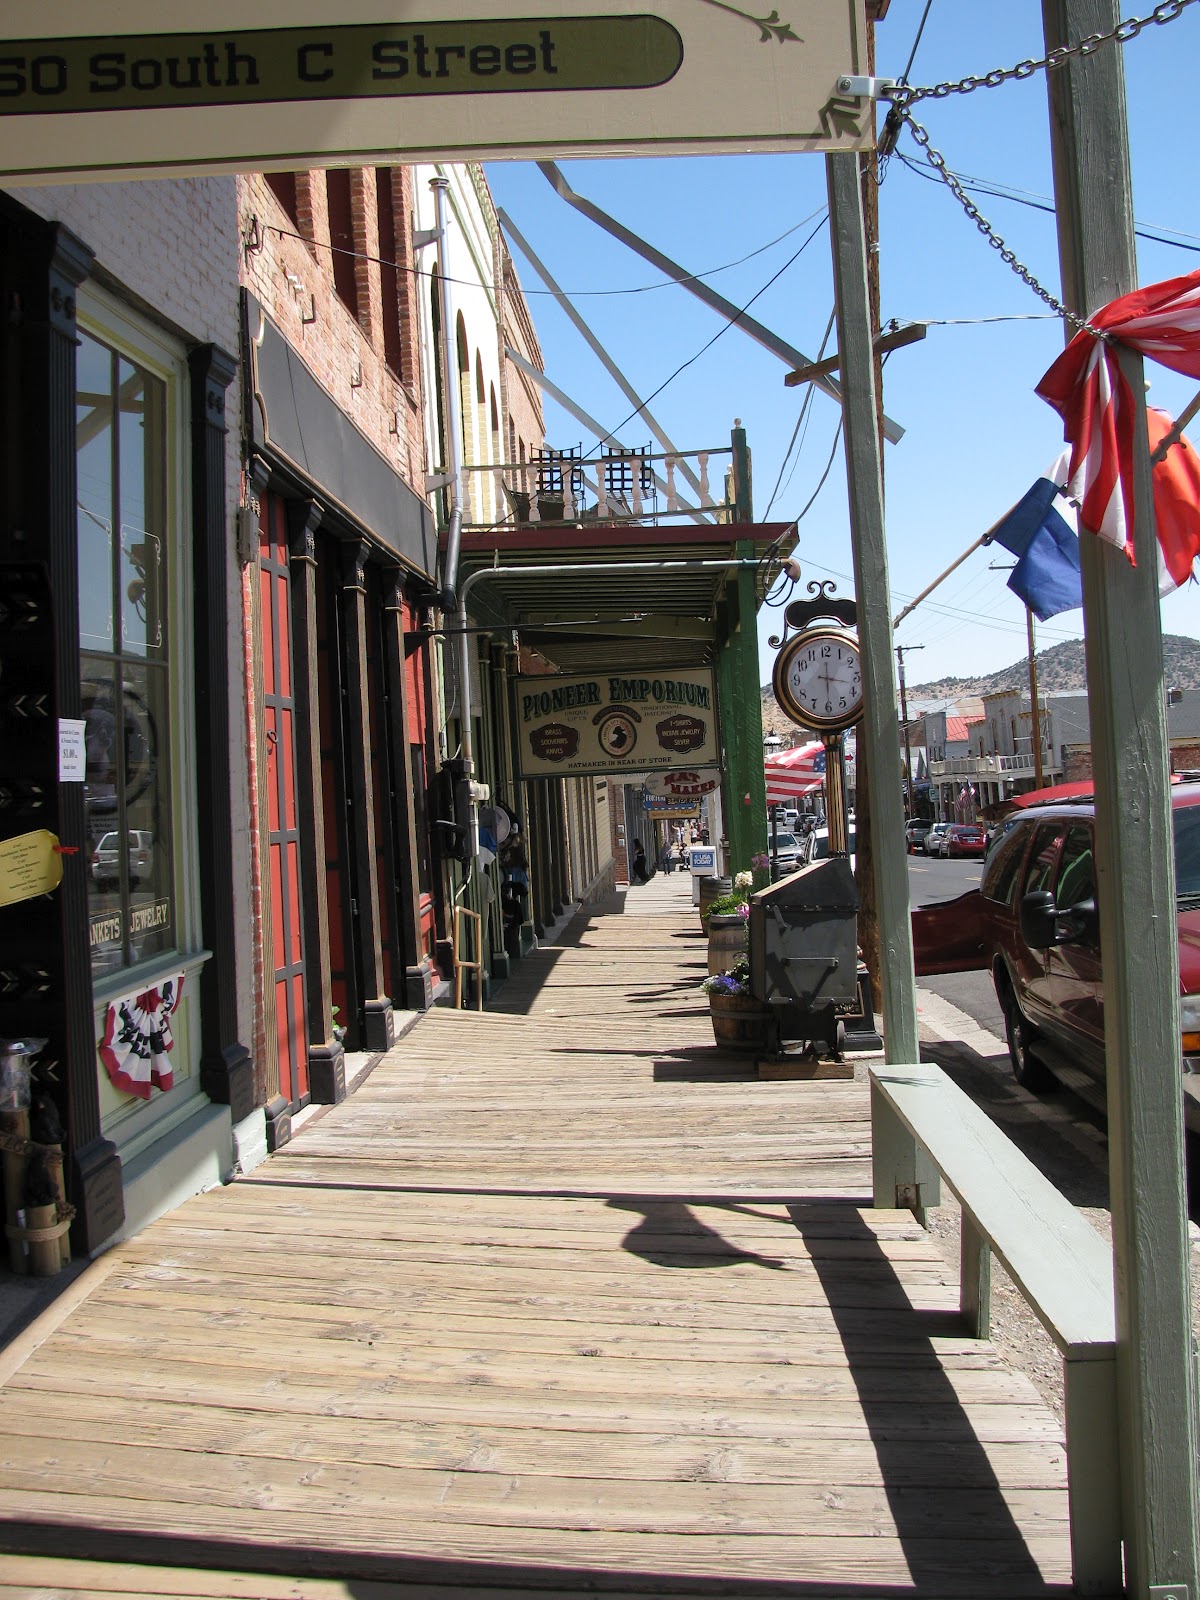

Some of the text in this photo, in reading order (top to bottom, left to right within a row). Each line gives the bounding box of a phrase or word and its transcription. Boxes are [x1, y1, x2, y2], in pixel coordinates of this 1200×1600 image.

[89, 42, 259, 93] South
[297, 43, 334, 83] C
[372, 31, 557, 81] Street
[808, 650, 816, 661] 11
[821, 645, 832, 658] 12
[837, 648, 841, 660] 1
[797, 660, 807, 672] 10
[846, 656, 854, 668] 2
[793, 674, 801, 686] 9
[853, 671, 861, 683] 3
[799, 688, 807, 700] 8
[849, 685, 857, 697] 4
[522, 677, 710, 721] PIONEER EMPORIUM
[810, 698, 817, 710] 7
[838, 696, 847, 708] 5
[825, 700, 832, 713] 6
[544, 728, 562, 736] BRASS
[662, 729, 679, 737] INDIAN
[540, 737, 568, 746] SOUVENIRS
[568, 760, 607, 768] HATMAKER
[608, 758, 616, 766] IN
[617, 757, 636, 765] REAR
[664, 772, 701, 786] HAT
[671, 780, 716, 795] MAKER
[130, 903, 168, 933] JEWELRY
